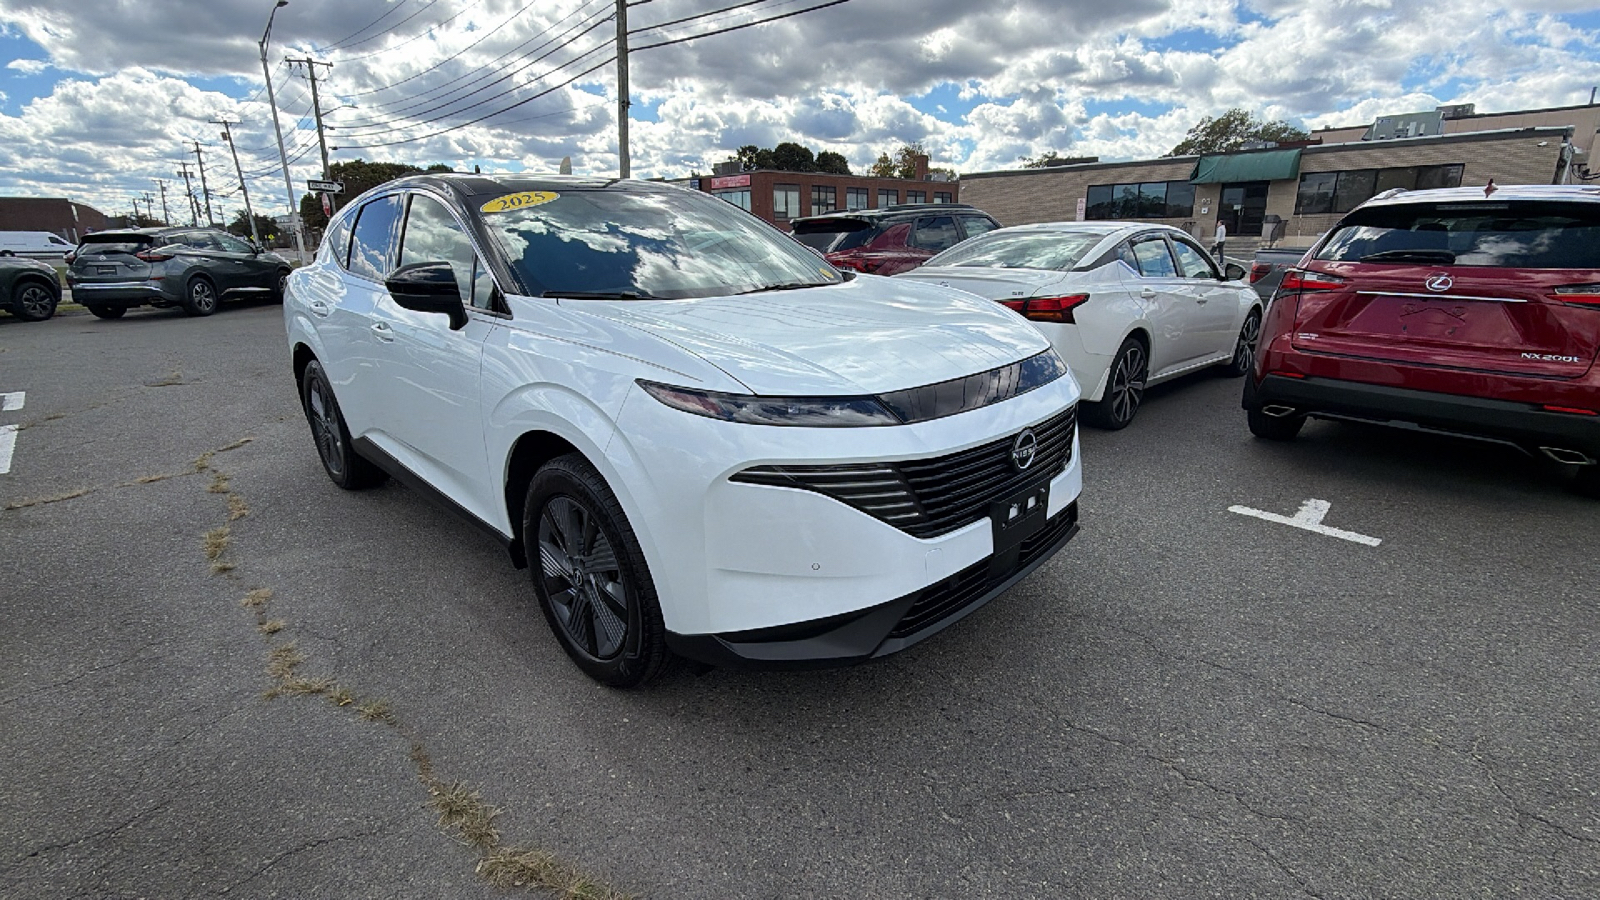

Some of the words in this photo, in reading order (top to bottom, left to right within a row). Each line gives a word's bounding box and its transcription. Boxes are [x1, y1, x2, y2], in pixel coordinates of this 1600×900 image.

[497, 192, 546, 210] 2025
[1521, 352, 1541, 360] NX
[1541, 354, 1580, 363] 200t
